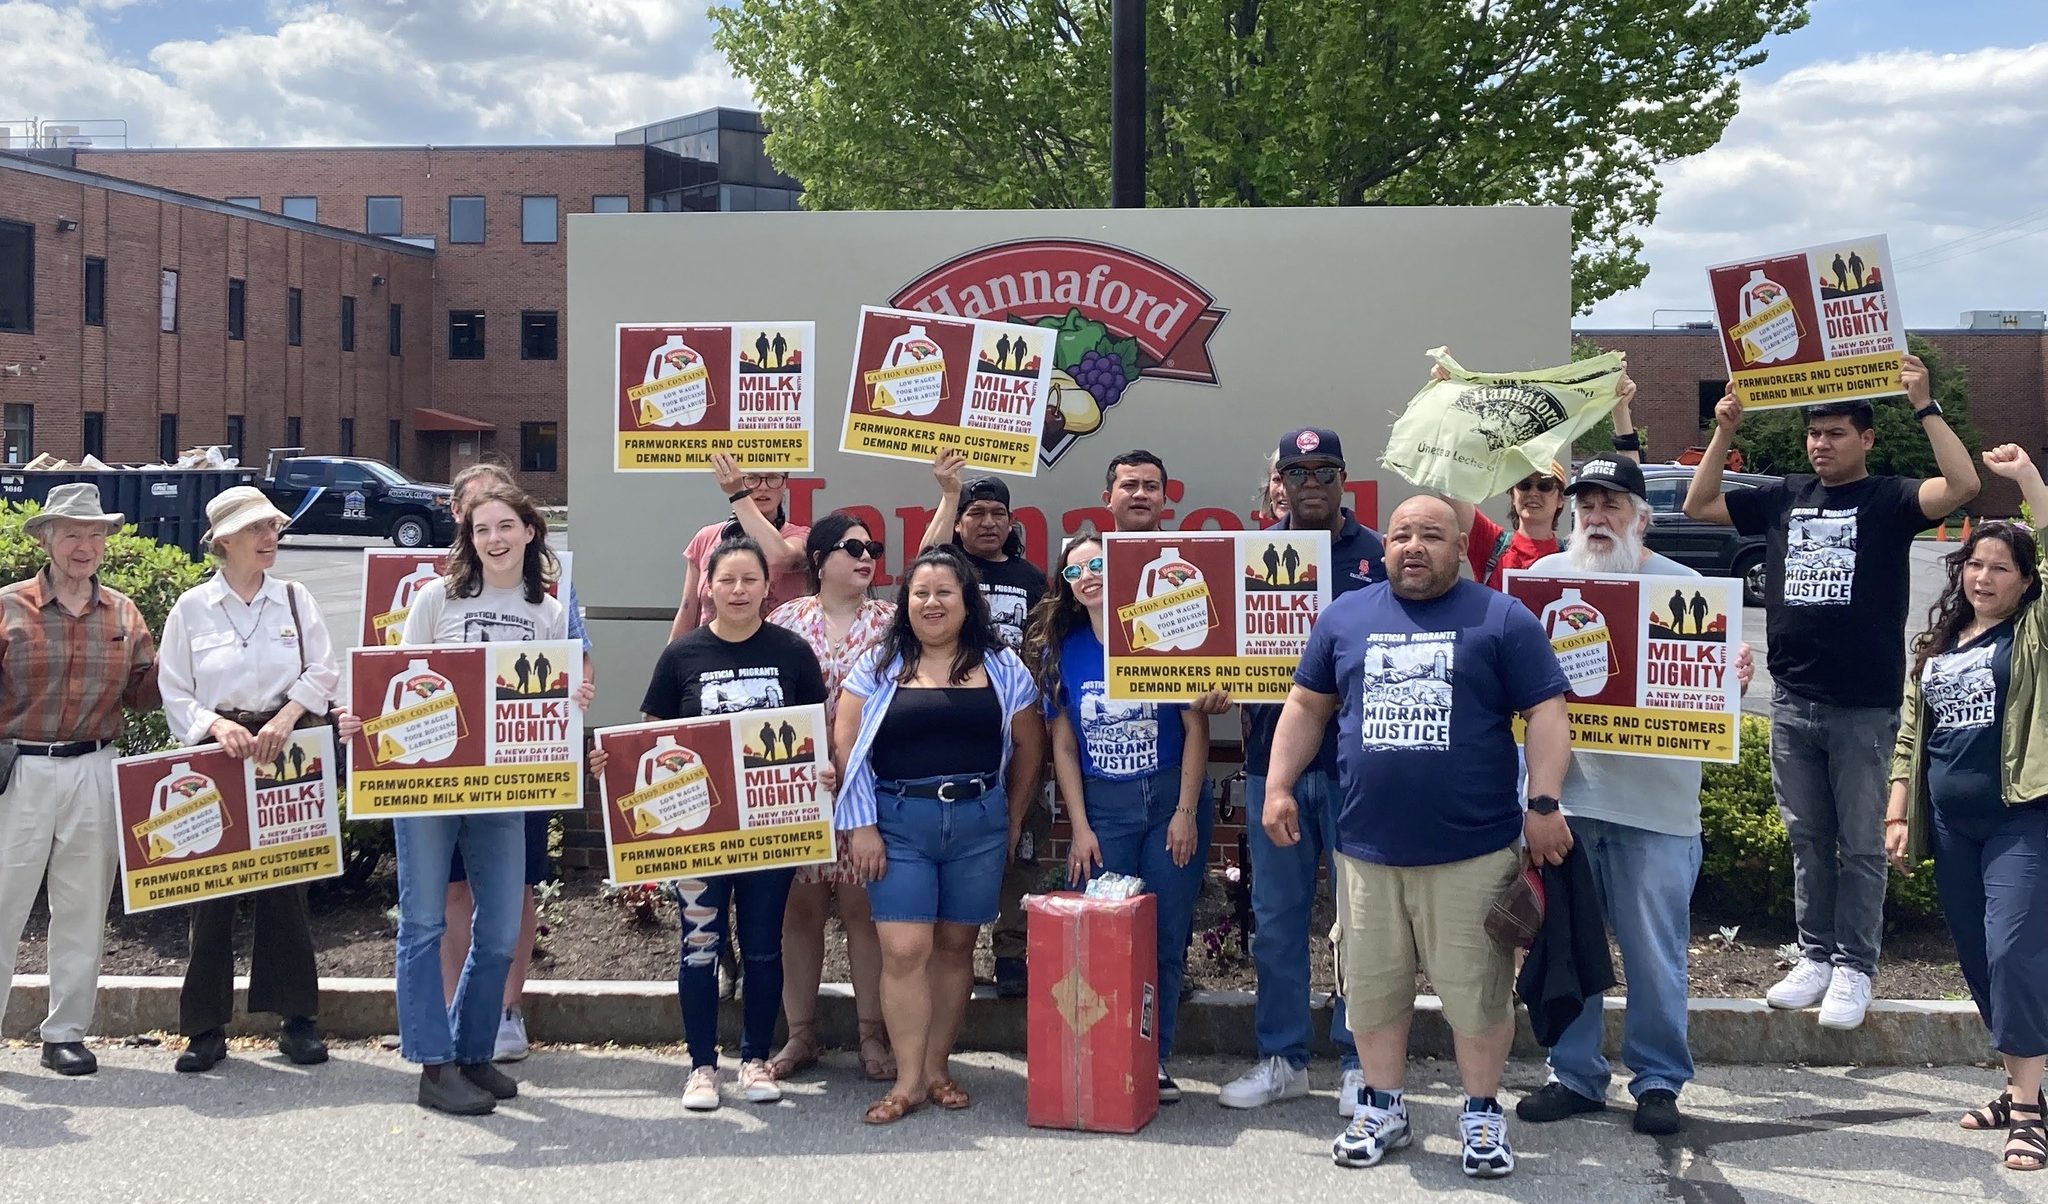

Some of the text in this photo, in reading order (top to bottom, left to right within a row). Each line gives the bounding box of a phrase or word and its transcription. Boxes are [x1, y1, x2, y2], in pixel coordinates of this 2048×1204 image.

[913, 264, 1188, 342] Hannaford
[1824, 295, 1879, 318] MILK
[1827, 311, 1891, 339] DIGNITY
[1876, 337, 1892, 345] FOR
[868, 364, 942, 381] CAUTION CONTAINS
[1737, 361, 1898, 388] FARMWORKERS AND CUSTOMERS
[631, 371, 705, 397] CAUTION CONTAINS
[740, 376, 794, 390] MILK
[974, 375, 1030, 394] MILK
[1749, 378, 1889, 400] DEMAND MILK WITH DIGNITY
[739, 392, 801, 411] DIGNITY
[971, 390, 1036, 415] DIGNITY
[625, 439, 802, 448] FARMWORKERS AND CUSTOMERS
[854, 422, 1029, 452] FARMWORKERS AND CUSTOMERS
[637, 454, 681, 462] DEMAND
[686, 454, 712, 462] MILK
[748, 453, 790, 462] DIGNITY
[863, 437, 908, 451] DEMAND
[911, 443, 938, 455] MILK
[973, 451, 1016, 465] DIGNITY
[1786, 570, 1851, 581] MIGRANT
[1785, 583, 1850, 597] JUSTICE
[1122, 588, 1205, 618] CAUTION CONTAINS
[1246, 594, 1309, 610] MILK
[464, 611, 497, 620] JUSTICIA
[1246, 612, 1318, 634] DIGNITY
[1367, 631, 1456, 641] JUSTICIA MIGRANTE
[1562, 633, 1606, 648] CONTAINS
[1649, 643, 1716, 662] MILK
[700, 667, 779, 681] JUSTICIA MIGRANTE
[1117, 666, 1296, 677] FARMWORKERS AND CUSTOM
[1648, 662, 1726, 688] DIGNITY
[1130, 682, 1295, 692] DEMAND MILK WITH DIGNI
[496, 702, 560, 720] MILK
[1365, 707, 1449, 721] MIGRANT
[496, 719, 569, 743] DIGNITY
[1364, 723, 1447, 742] JUSTICE
[1614, 716, 1639, 728] AND
[1645, 718, 1725, 734] CUSTOMERS
[1089, 739, 1156, 754] MIGRANT
[1582, 731, 1613, 743] MILK
[1619, 734, 1651, 746] WITH
[1657, 737, 1710, 750] DIGNITY
[360, 772, 570, 791] FARMWORKERS AND CUSTOMERS
[745, 766, 808, 787] MILK
[257, 784, 316, 808] MILK
[374, 788, 556, 806] DEMAND MILK WITH DIGNITY
[747, 781, 819, 808] DIGNITY
[258, 798, 326, 828] DIGNITY
[621, 830, 823, 861] FARMWORKERS AND CUSTOMERS
[135, 844, 330, 888] FARMWORKERS AND CUSTOMERS
[636, 846, 811, 875] DEMAND MILK WITH DIGNITY
[149, 861, 318, 900] DEMAND MILK WITH DIGNITY
